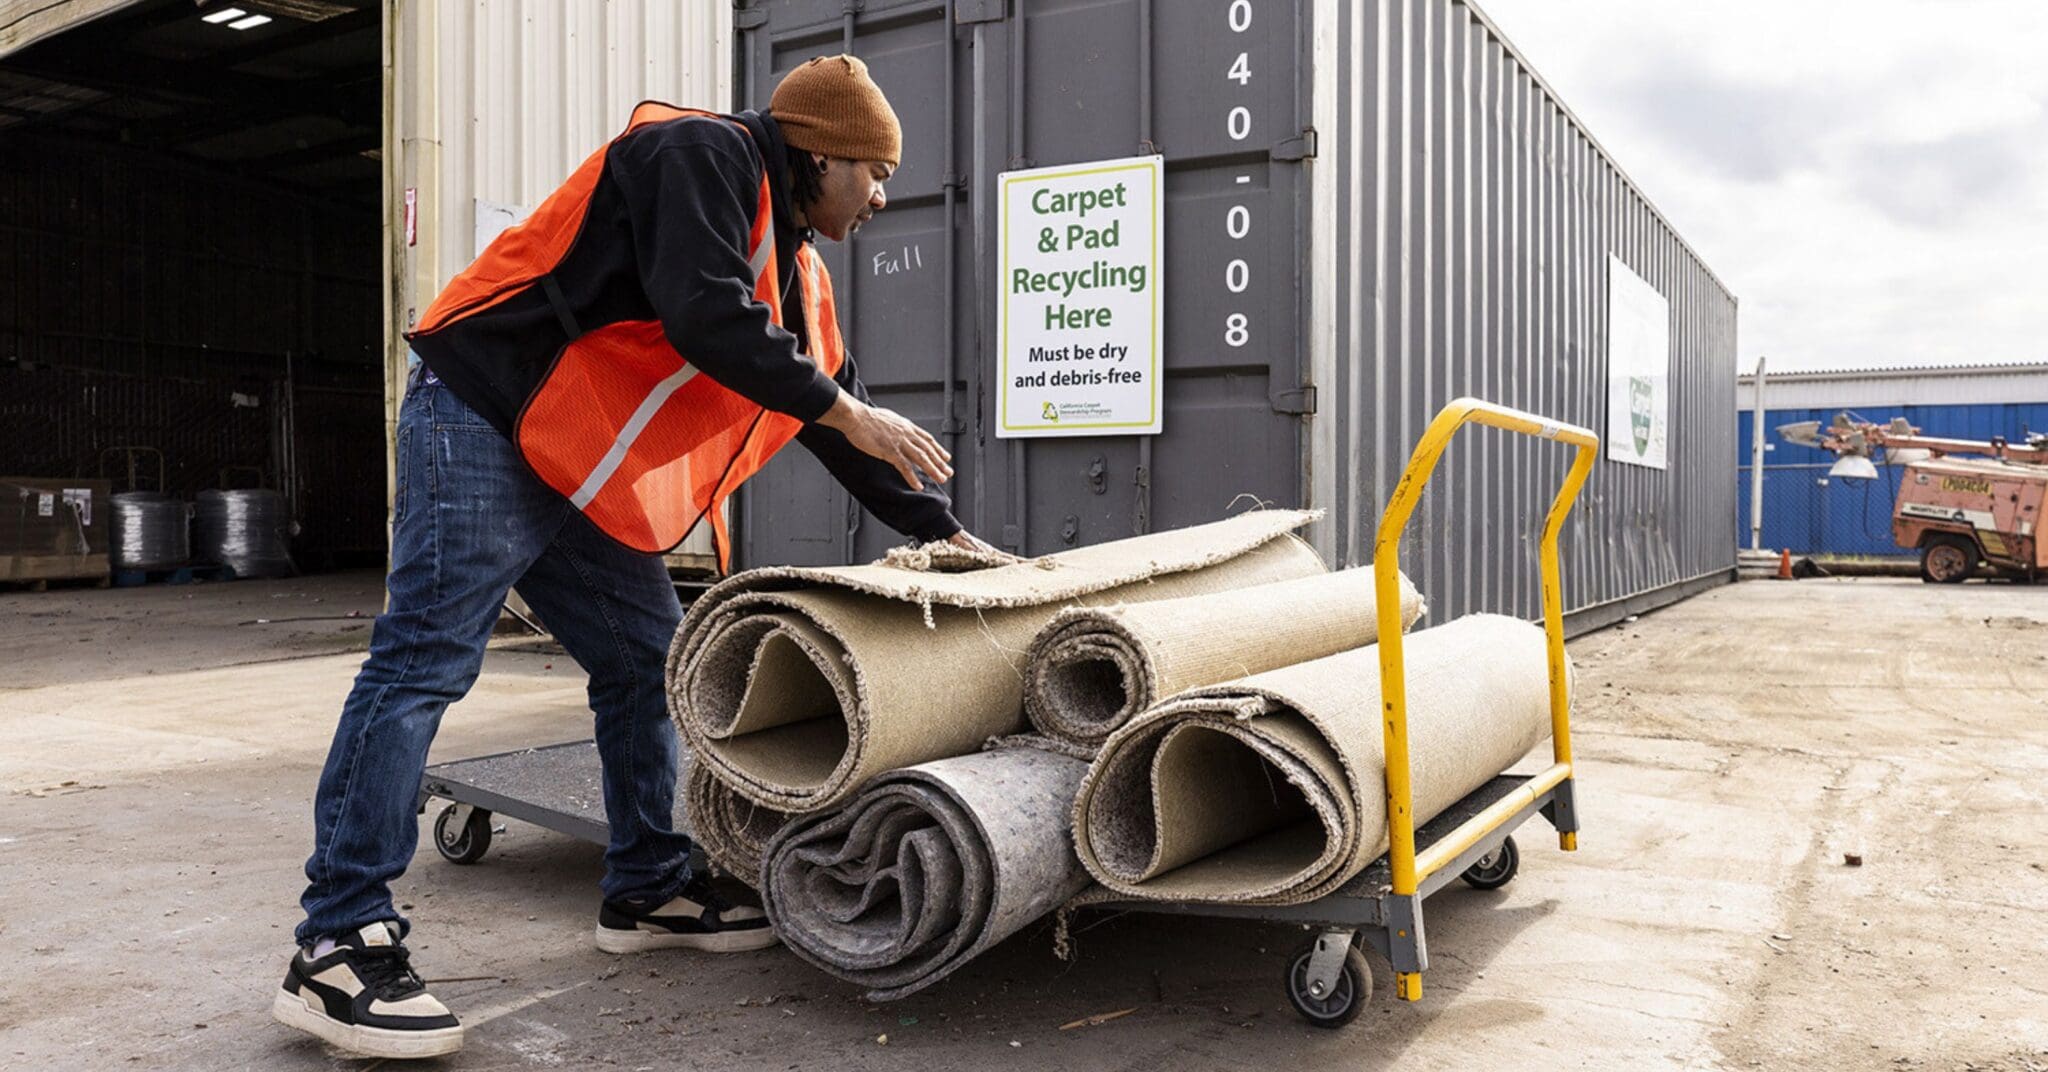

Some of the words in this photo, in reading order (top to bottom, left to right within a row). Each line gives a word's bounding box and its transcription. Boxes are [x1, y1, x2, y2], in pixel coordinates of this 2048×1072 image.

[1031, 182, 1127, 217] Carpet
[1037, 227, 1060, 253] &
[1066, 219, 1120, 250] Pad
[873, 245, 922, 276] Full
[1012, 261, 1147, 298] Recycling
[1045, 304, 1113, 330] Here
[1028, 346, 1070, 363] Must
[1073, 344, 1095, 361] be
[1098, 342, 1129, 362] dry
[1014, 370, 1046, 388] and
[1049, 367, 1143, 387] debris-free
